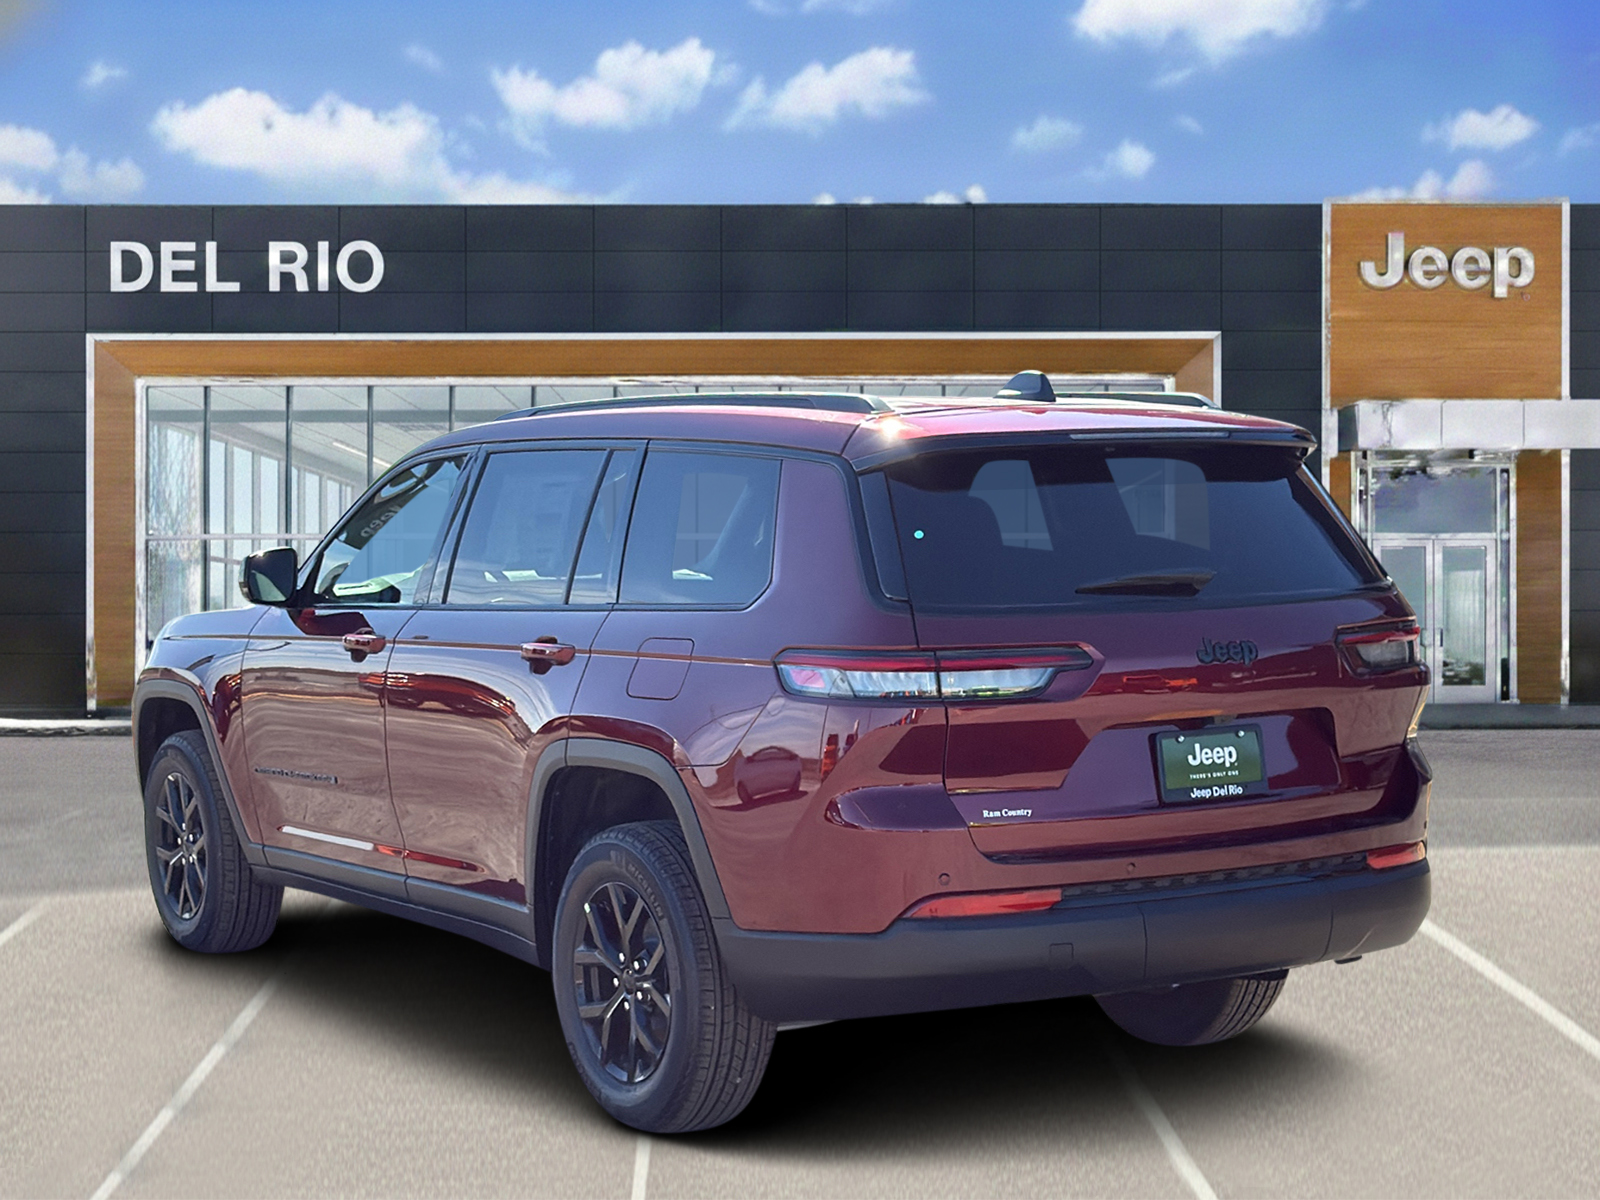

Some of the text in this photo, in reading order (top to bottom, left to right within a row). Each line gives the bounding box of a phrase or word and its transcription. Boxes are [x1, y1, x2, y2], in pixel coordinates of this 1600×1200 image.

[110, 240, 384, 292] DEL RIO
[1359, 231, 1535, 298] Jeep
[1196, 637, 1258, 666] Jeep
[1187, 743, 1237, 768] Jeep
[1212, 770, 1226, 778] ONLY
[1190, 784, 1243, 799] Jeep Del Rio
[982, 808, 1032, 818] Ram Country
